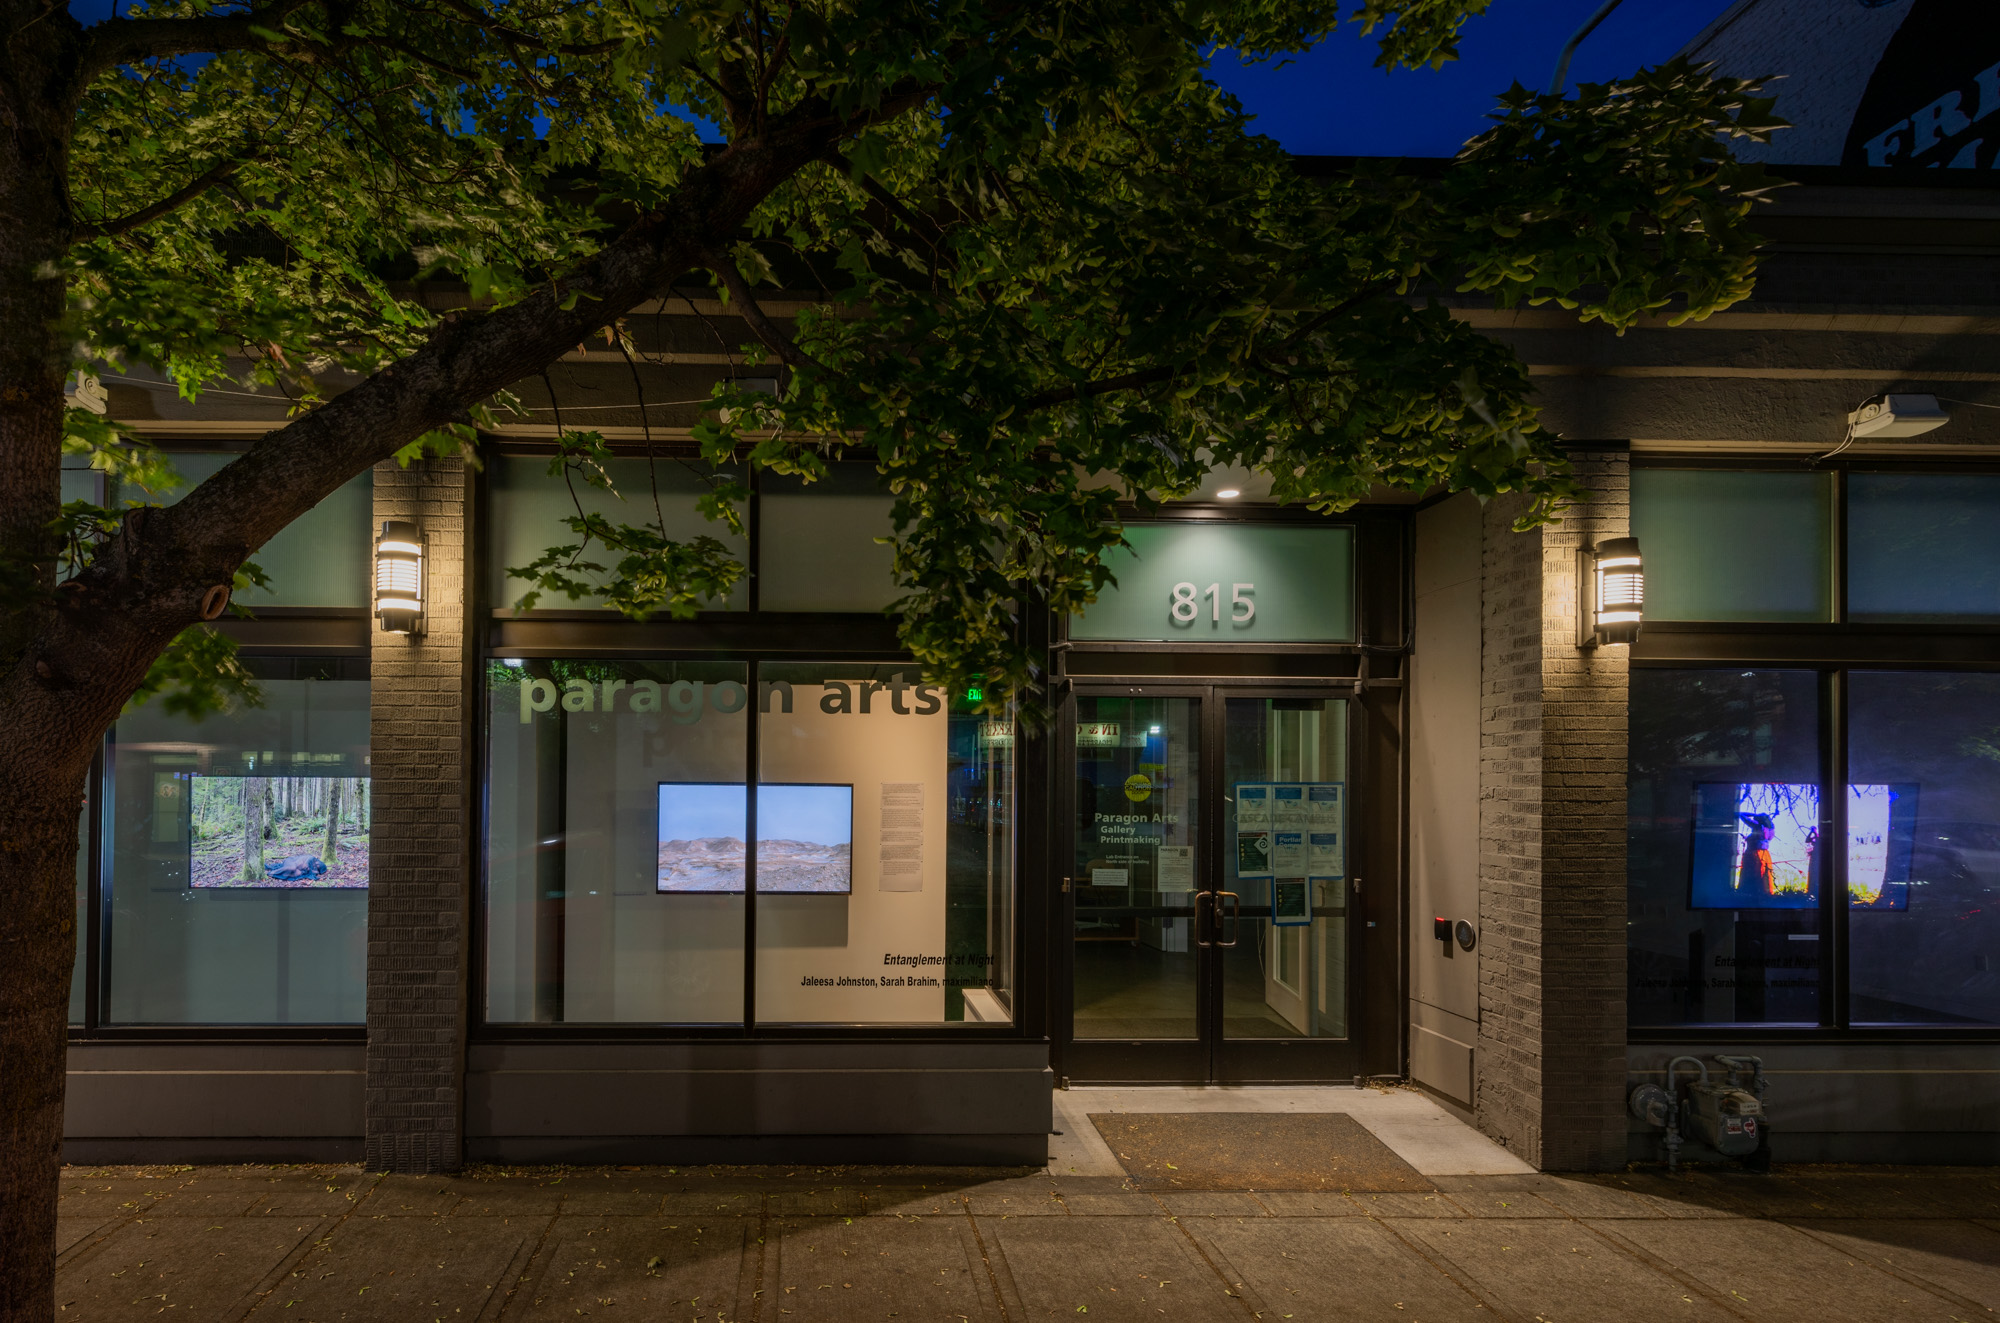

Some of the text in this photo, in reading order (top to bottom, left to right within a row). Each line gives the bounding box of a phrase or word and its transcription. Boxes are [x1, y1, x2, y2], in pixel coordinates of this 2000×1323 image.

[1172, 582, 1255, 621] 815
[519, 672, 941, 725] paragon arts
[1095, 813, 1179, 825] Paragon Arts
[1101, 826, 1136, 835] Gallery
[1101, 836, 1160, 846] Printmaking
[884, 954, 994, 967] Entanglement at Night
[801, 976, 994, 988] Jaleesa Johnston, Sarah Brahim, maximiliano
